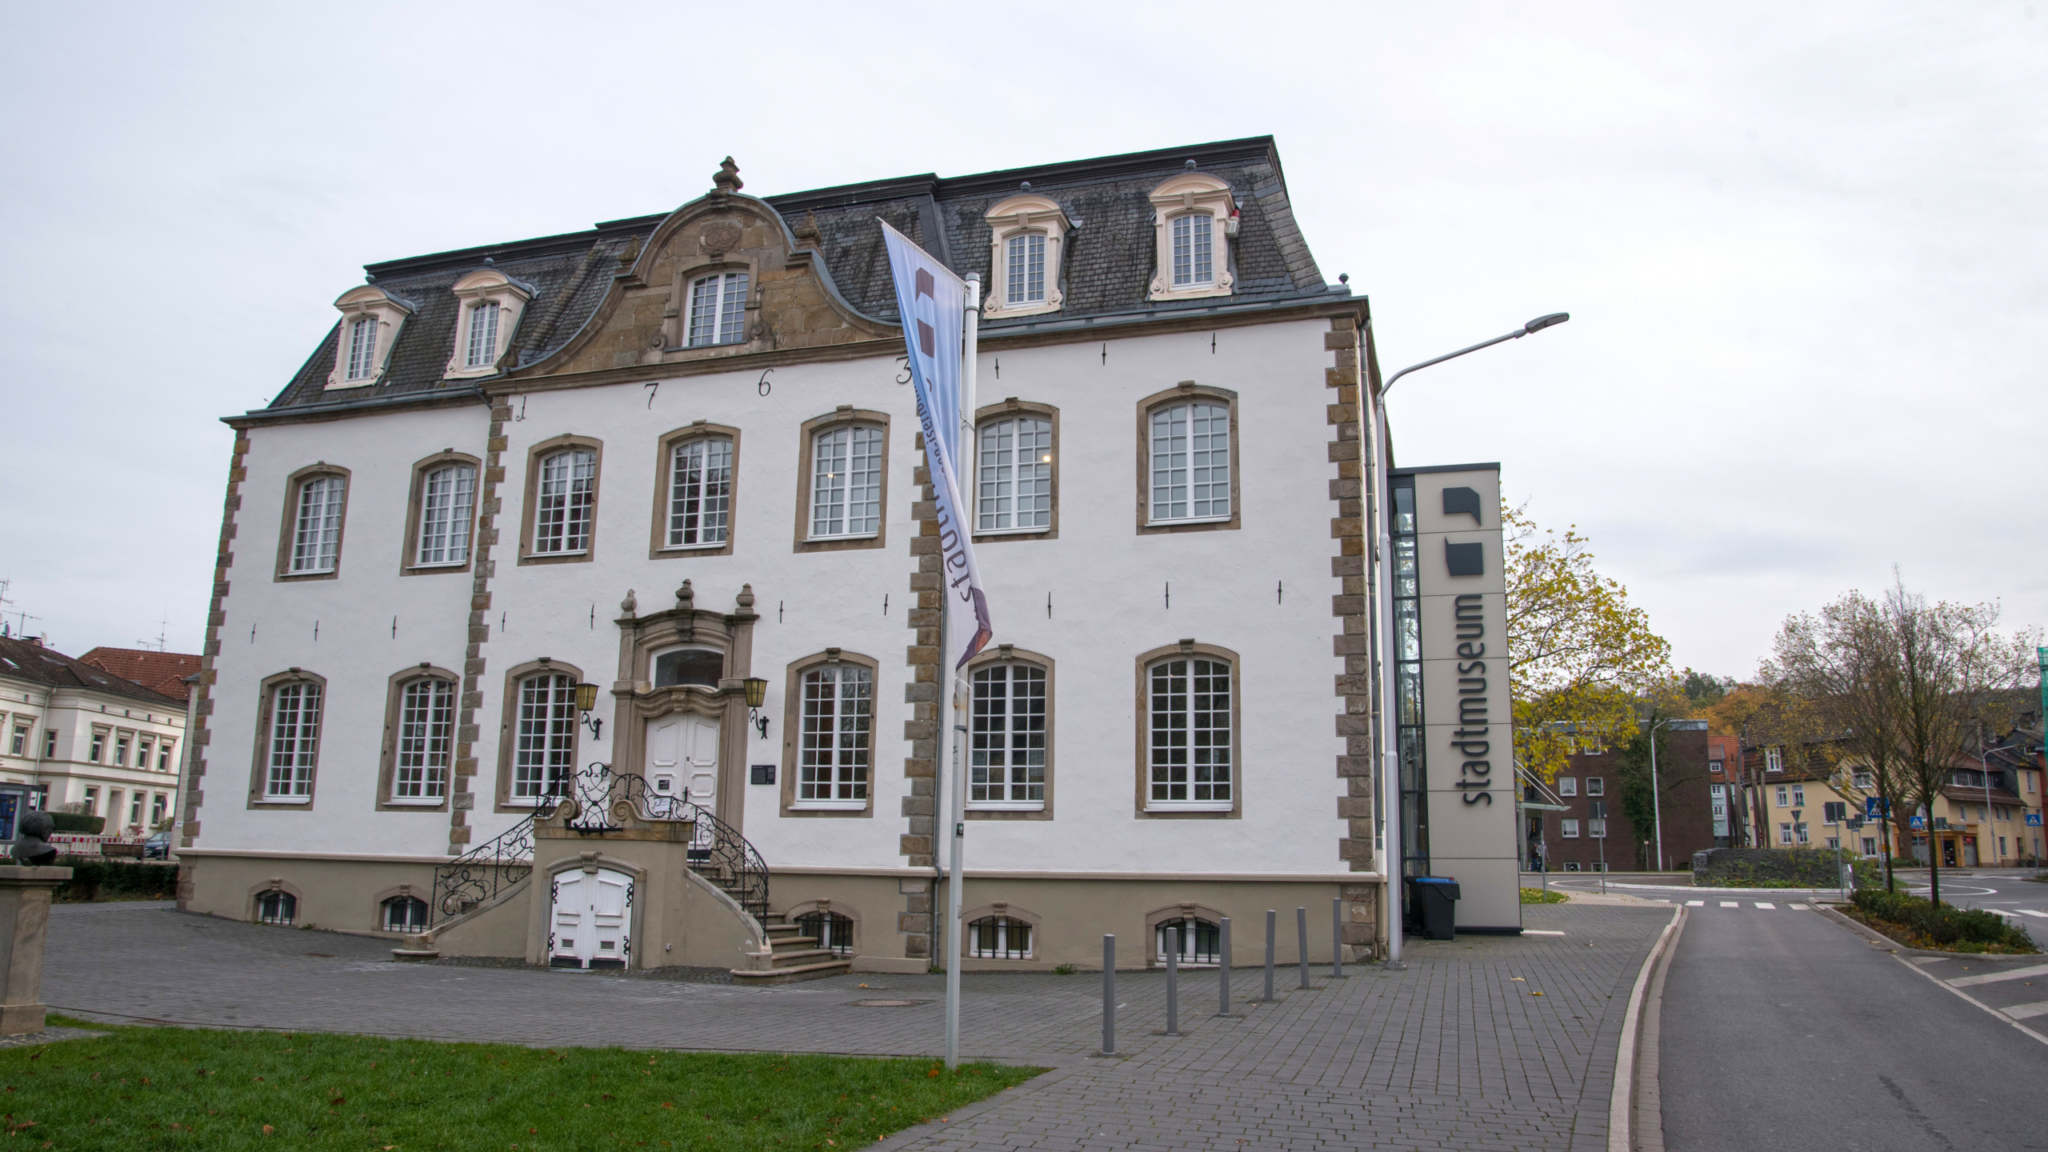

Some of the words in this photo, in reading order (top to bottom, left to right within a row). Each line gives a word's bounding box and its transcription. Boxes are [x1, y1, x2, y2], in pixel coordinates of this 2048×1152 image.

[644, 382, 660, 410] 7
[757, 368, 774, 397] 6
[895, 355, 912, 385] 3
[1450, 593, 1492, 807] stadtmuseum
